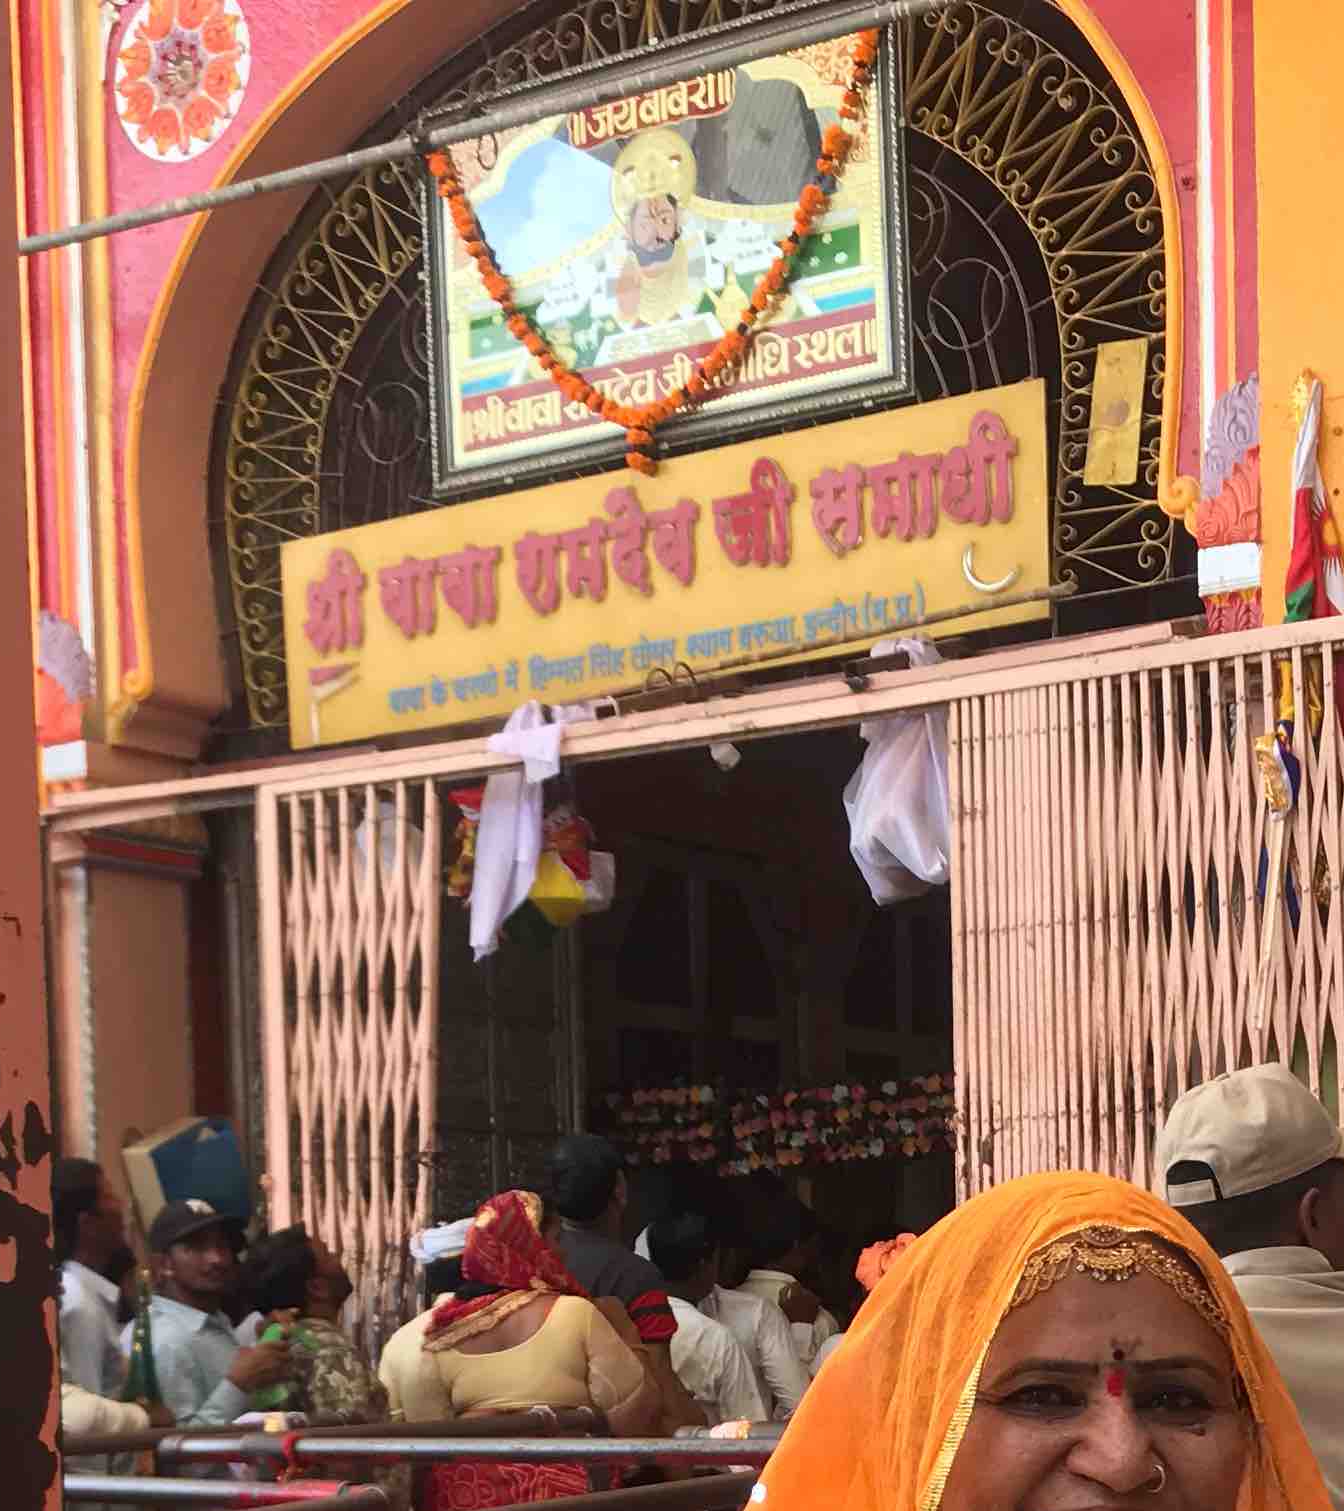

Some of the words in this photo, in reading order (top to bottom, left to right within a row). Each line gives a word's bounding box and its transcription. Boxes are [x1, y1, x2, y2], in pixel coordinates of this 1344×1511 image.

[304, 548, 364, 656] श्री
[380, 544, 500, 638] बाबा
[515, 486, 698, 616] रामदेव
[712, 457, 793, 567] जी
[810, 410, 1018, 557] समाधी
